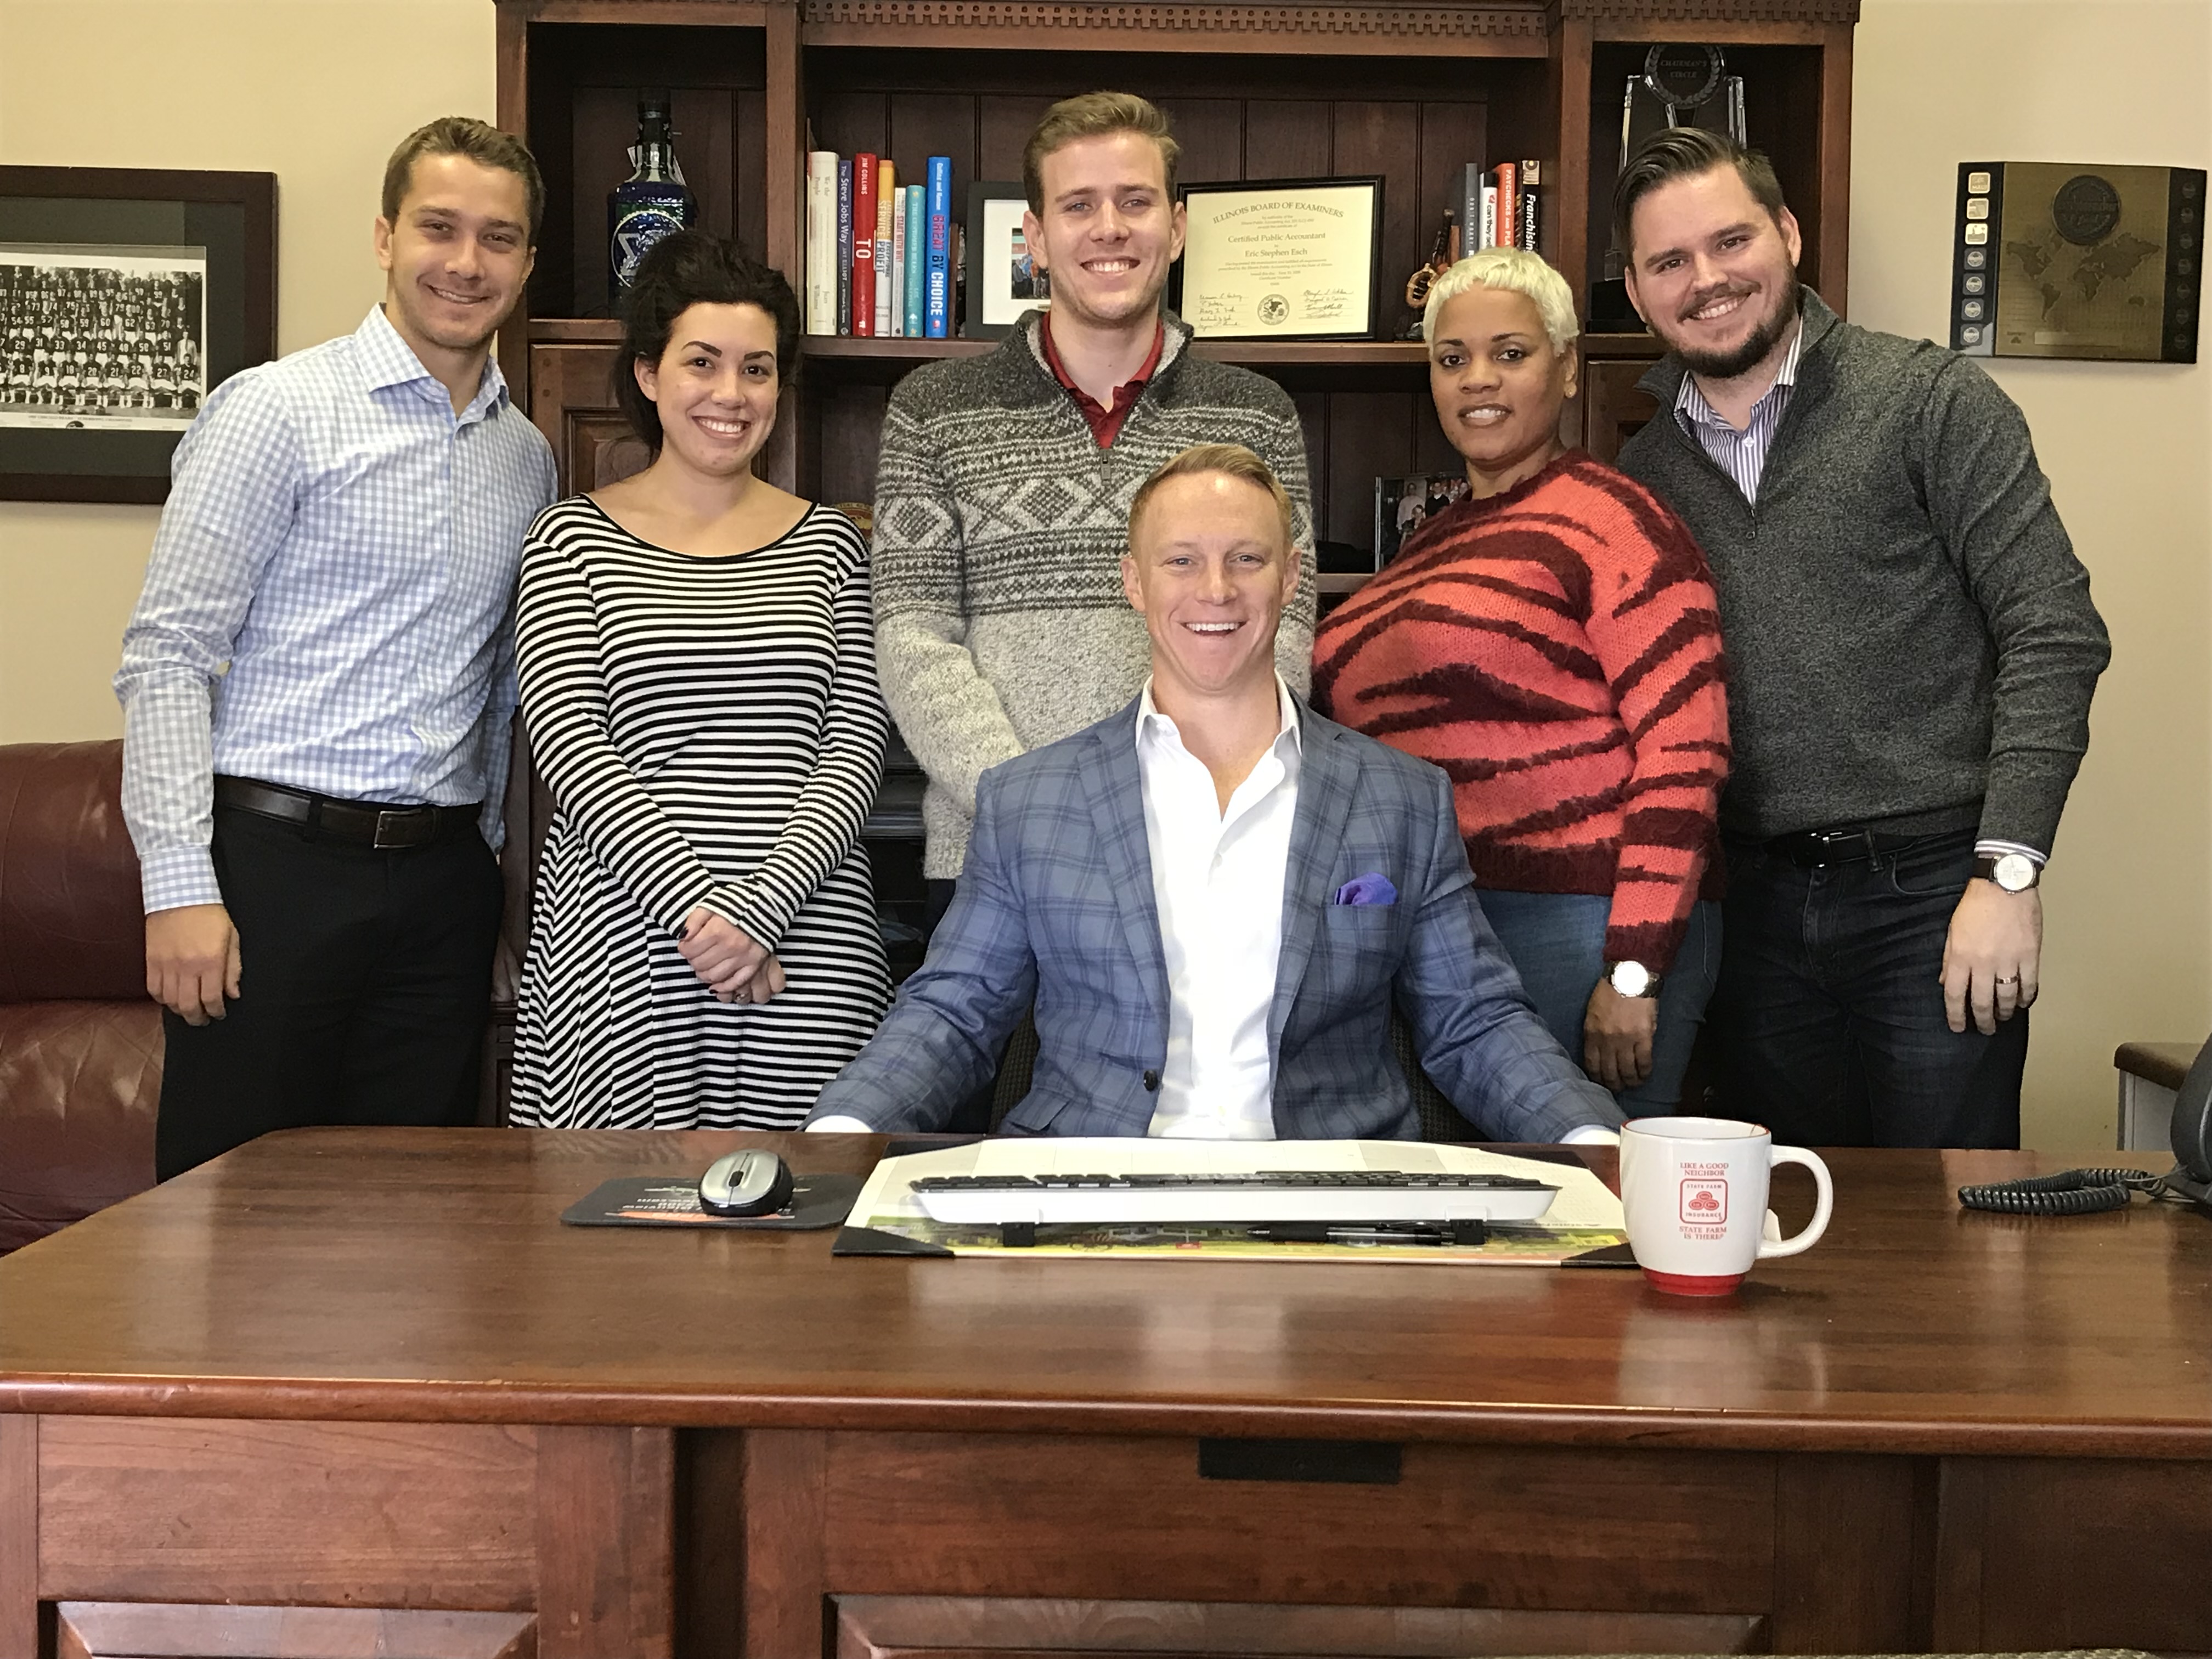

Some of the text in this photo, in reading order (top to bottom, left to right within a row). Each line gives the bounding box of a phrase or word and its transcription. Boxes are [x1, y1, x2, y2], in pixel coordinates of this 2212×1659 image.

[840, 178, 849, 201] Steve
[840, 203, 849, 223] Jobs
[1212, 206, 1249, 224] ILLINOIS
[1250, 202, 1280, 212] BOARD
[1295, 202, 1344, 218] EXAMINERS
[877, 200, 887, 237] SERVICE
[839, 225, 849, 244] Way
[1228, 235, 1259, 243] Certified
[856, 239, 871, 258] TO
[876, 241, 885, 274] PROFIT
[1260, 249, 1289, 258] Stephen
[930, 215, 944, 316] GREAT BY CHOICE
[24, 316, 35, 325] 55
[60, 319, 70, 328] 58
[80, 319, 89, 327] 59
[100, 318, 111, 326] 60
[125, 318, 136, 327] 62
[145, 321, 155, 330] 63
[15, 340, 25, 349] 29
[35, 337, 43, 347] 31
[55, 340, 65, 350] 33
[76, 341, 86, 350] 34
[97, 341, 107, 351] 45
[163, 342, 171, 351] 51
[19, 364, 25, 373] 8
[44, 366, 50, 376] 9
[88, 367, 97, 376] 20
[110, 368, 119, 377] 21
[131, 365, 142, 375] 22
[184, 369, 194, 379] 24
